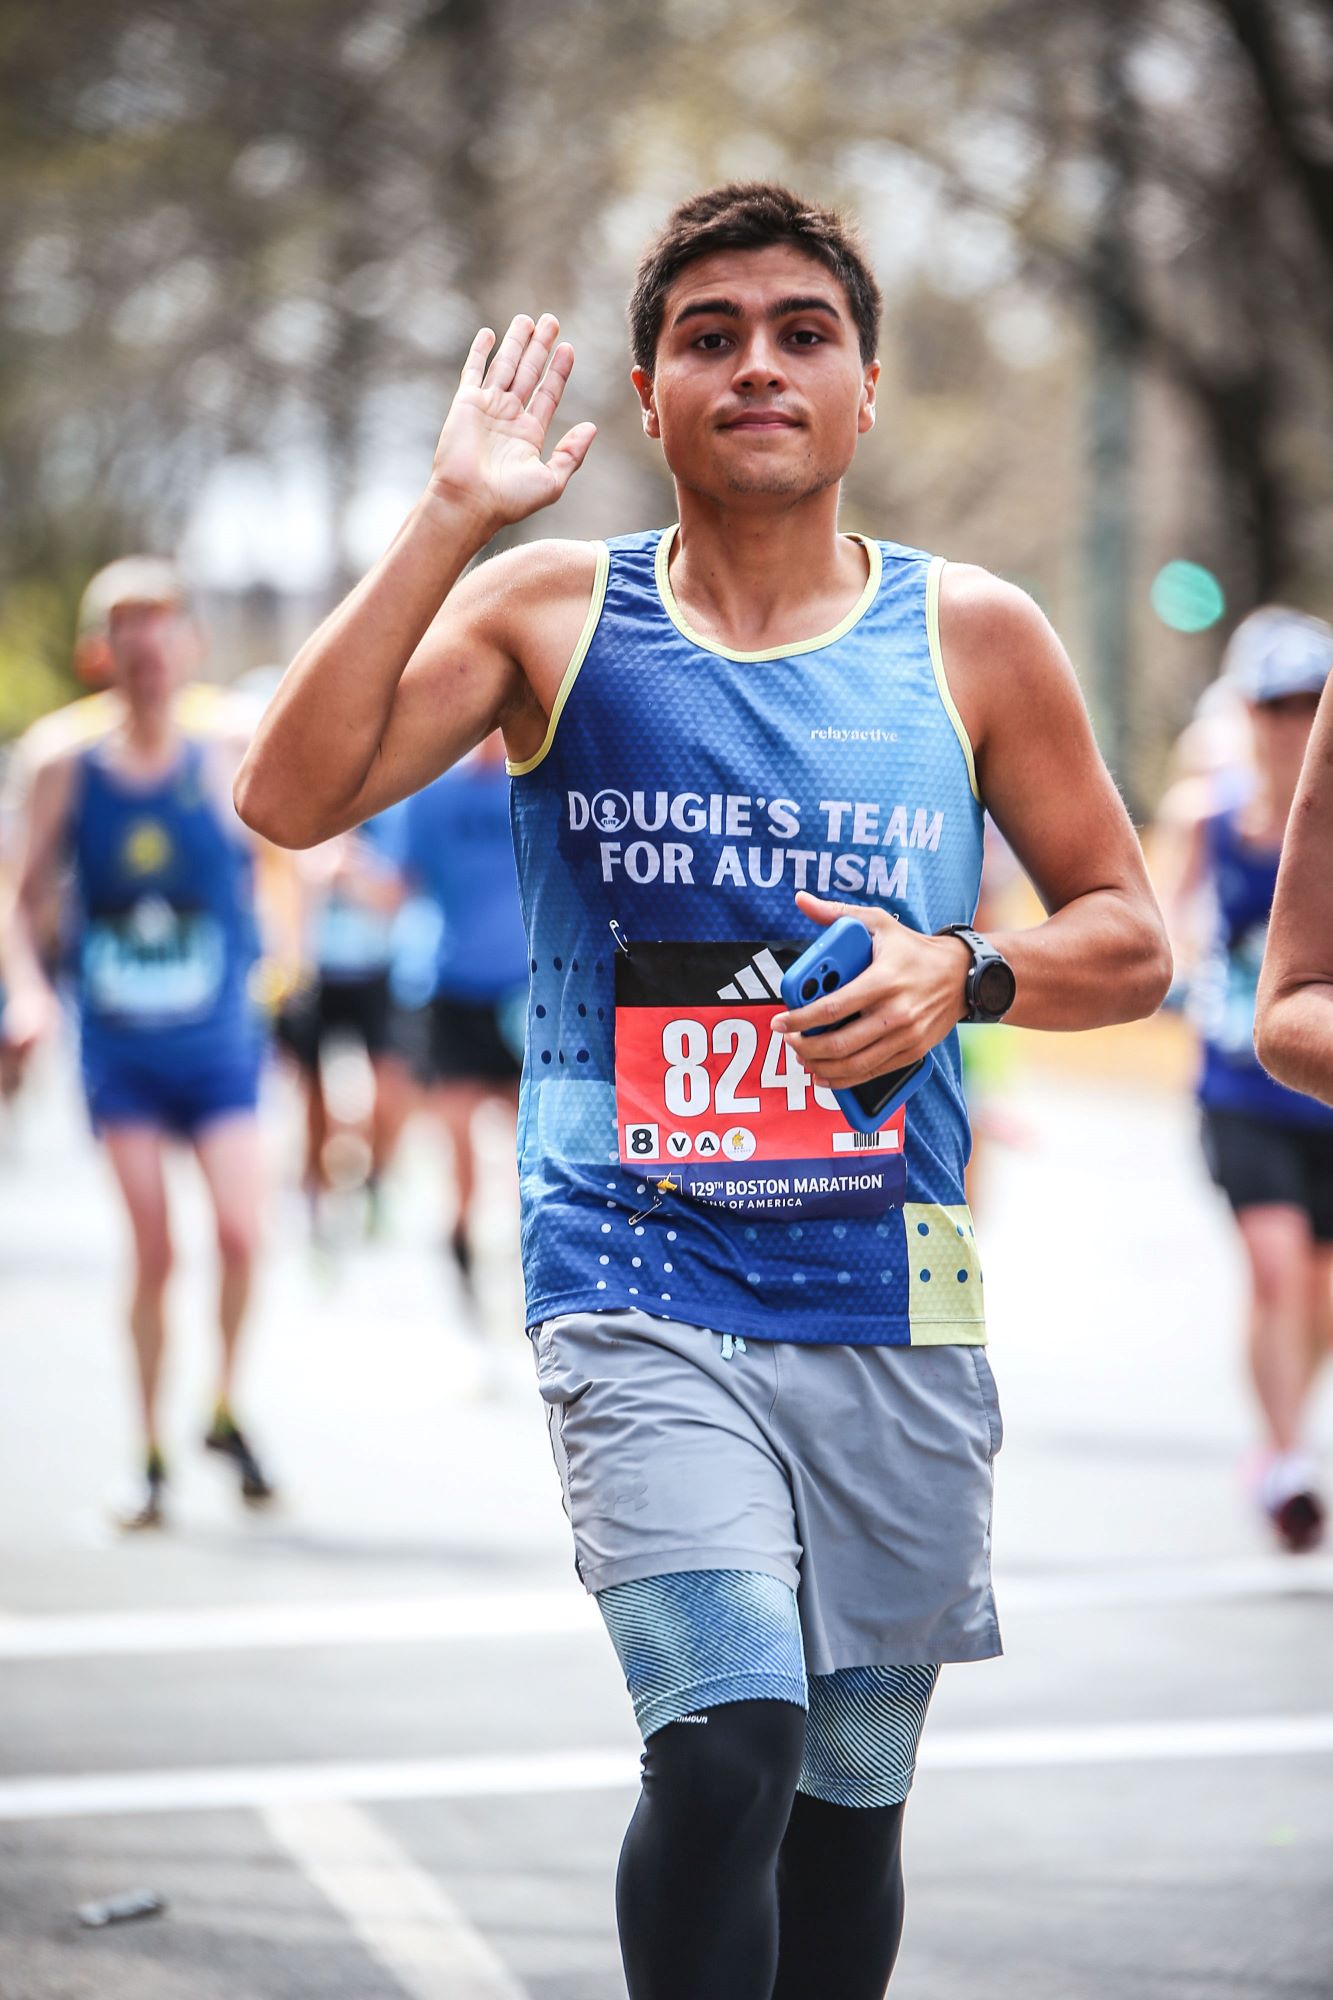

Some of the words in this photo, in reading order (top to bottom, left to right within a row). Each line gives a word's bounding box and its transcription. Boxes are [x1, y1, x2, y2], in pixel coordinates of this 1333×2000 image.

[810, 726, 899, 743] relayactive
[819, 801, 945, 852] TEAM
[600, 840, 695, 885] FOR
[712, 845, 909, 899] AUTISM
[661, 1018, 843, 1118] 824
[631, 1128, 654, 1154] 8
[671, 1137, 687, 1152] V
[700, 1136, 716, 1151] A
[689, 1181, 724, 1197] 129TH
[726, 1177, 790, 1196] BOSTON
[794, 1173, 884, 1194] MARATHON
[729, 1200, 744, 1209] OF
[747, 1197, 803, 1209] AMERICA
